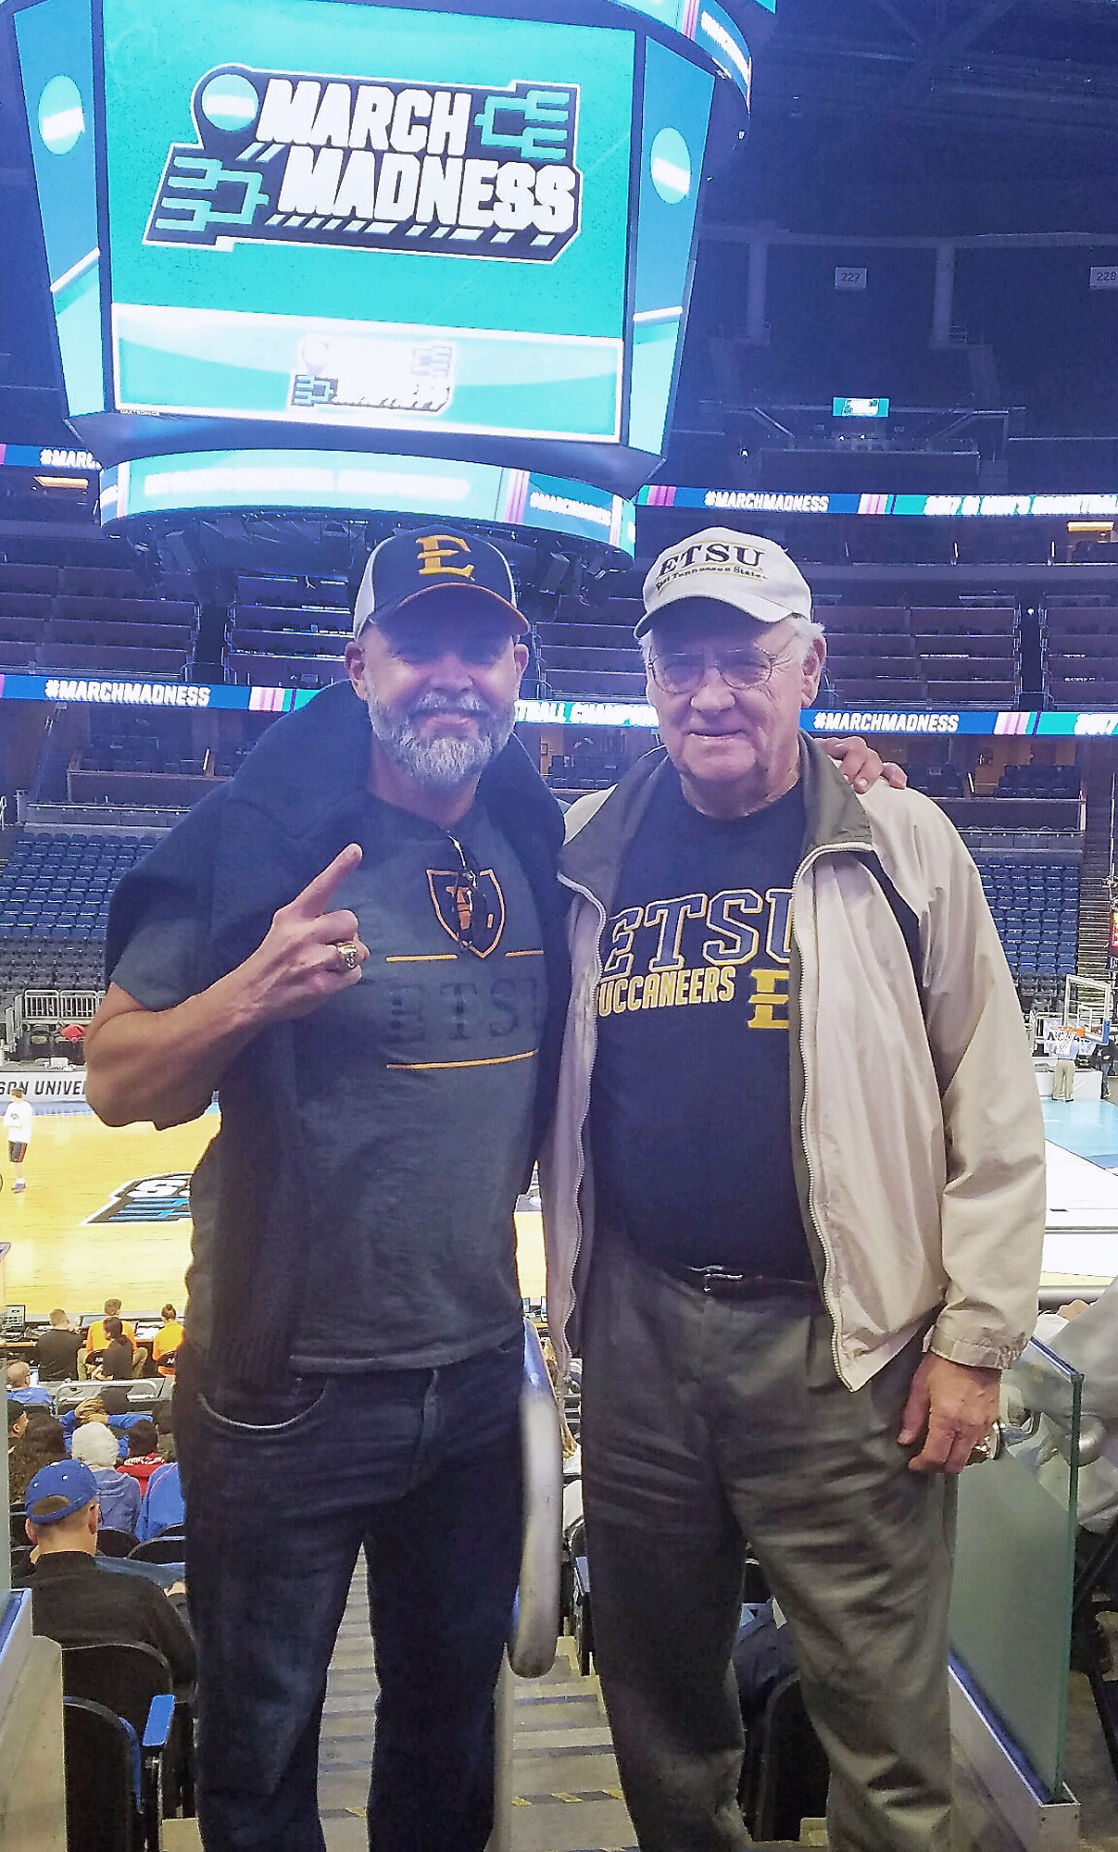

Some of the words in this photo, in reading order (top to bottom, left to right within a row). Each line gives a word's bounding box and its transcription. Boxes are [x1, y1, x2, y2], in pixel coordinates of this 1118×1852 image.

[256, 79, 473, 157] MARCH
[276, 147, 578, 235] MADNESS
[704, 490, 830, 513] #MARCHMADNESS
[415, 534, 476, 582] E
[655, 542, 765, 580] ETSU
[45, 679, 211, 707] #MARCHMADNESS
[812, 711, 960, 733] #MARCHMADNESS
[598, 965, 737, 1018] UCCANEERS
